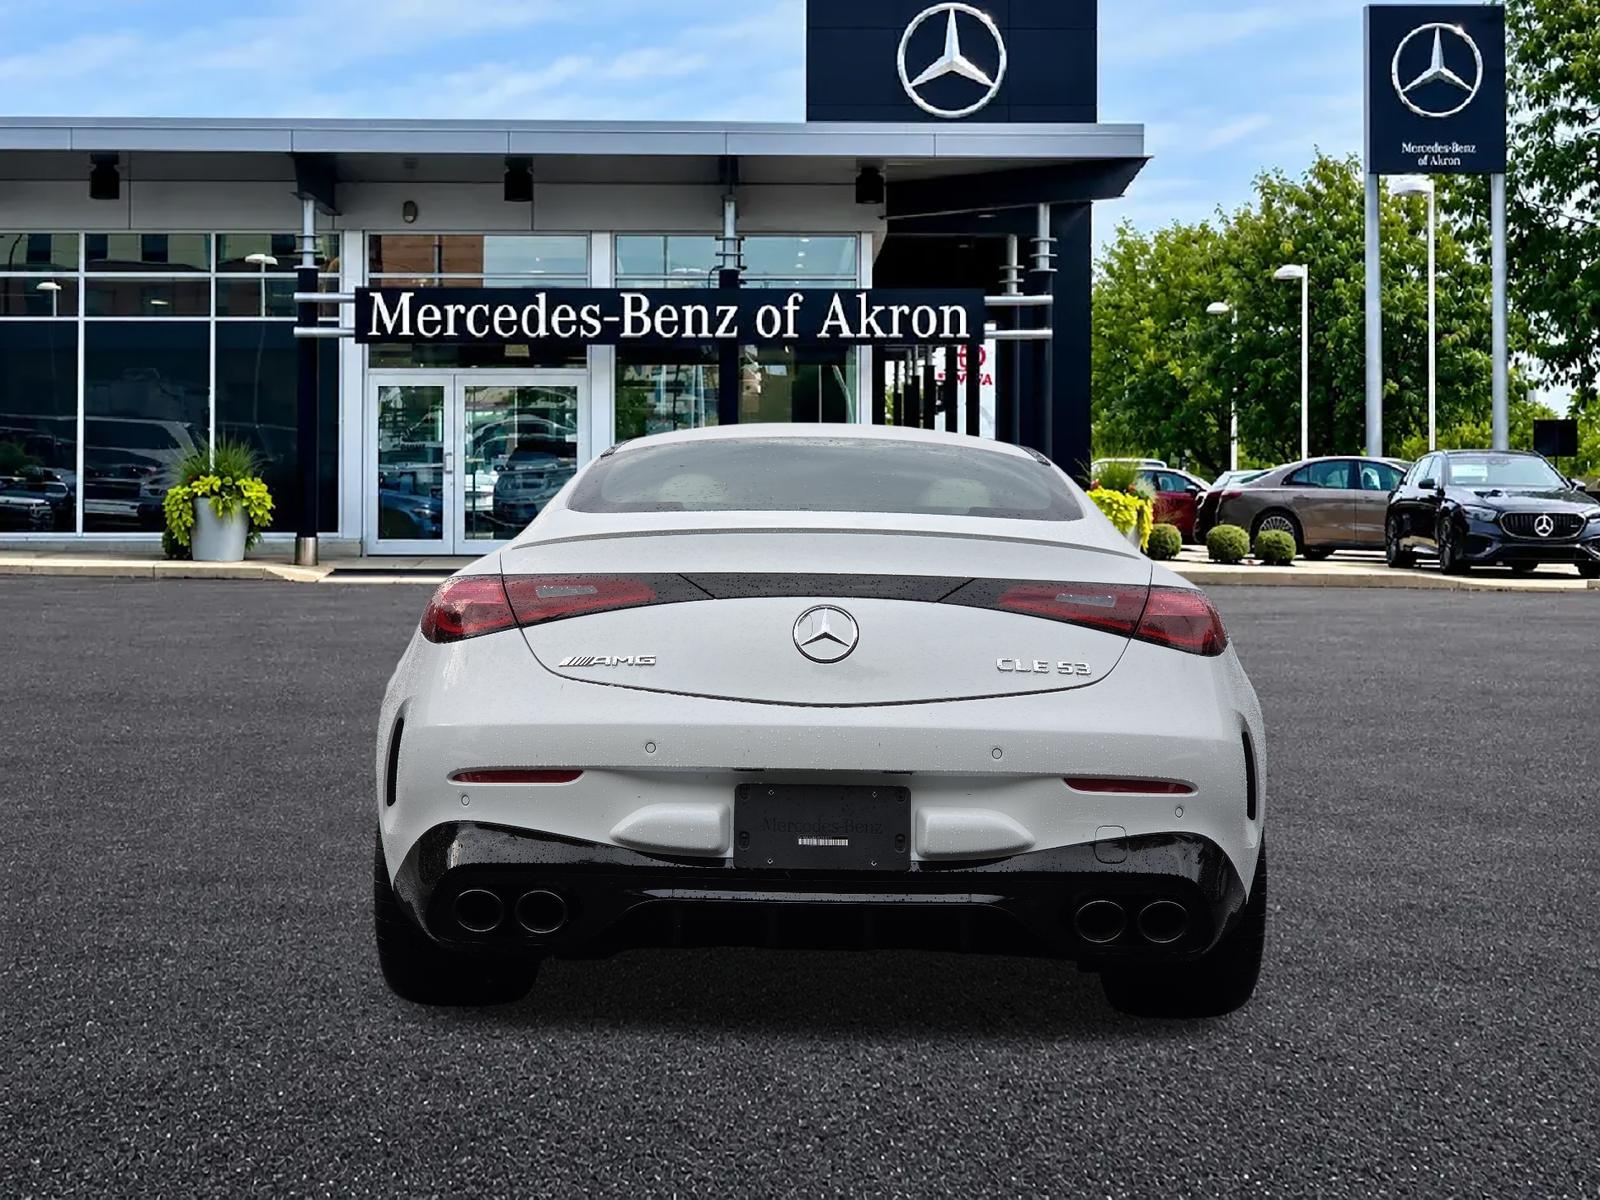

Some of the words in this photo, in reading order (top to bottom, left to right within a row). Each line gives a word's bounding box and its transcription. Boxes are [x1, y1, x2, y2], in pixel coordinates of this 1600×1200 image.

[1401, 142, 1477, 154] Mercedes-Benz
[1417, 154, 1429, 166] of
[1430, 154, 1461, 166] Akron
[367, 291, 739, 339] Mercedes-Benz
[755, 292, 804, 339] of
[816, 291, 971, 339] Akron
[996, 658, 1050, 673] CLE
[1057, 661, 1092, 676] 53
[762, 816, 884, 835] Mercedes-Benz
